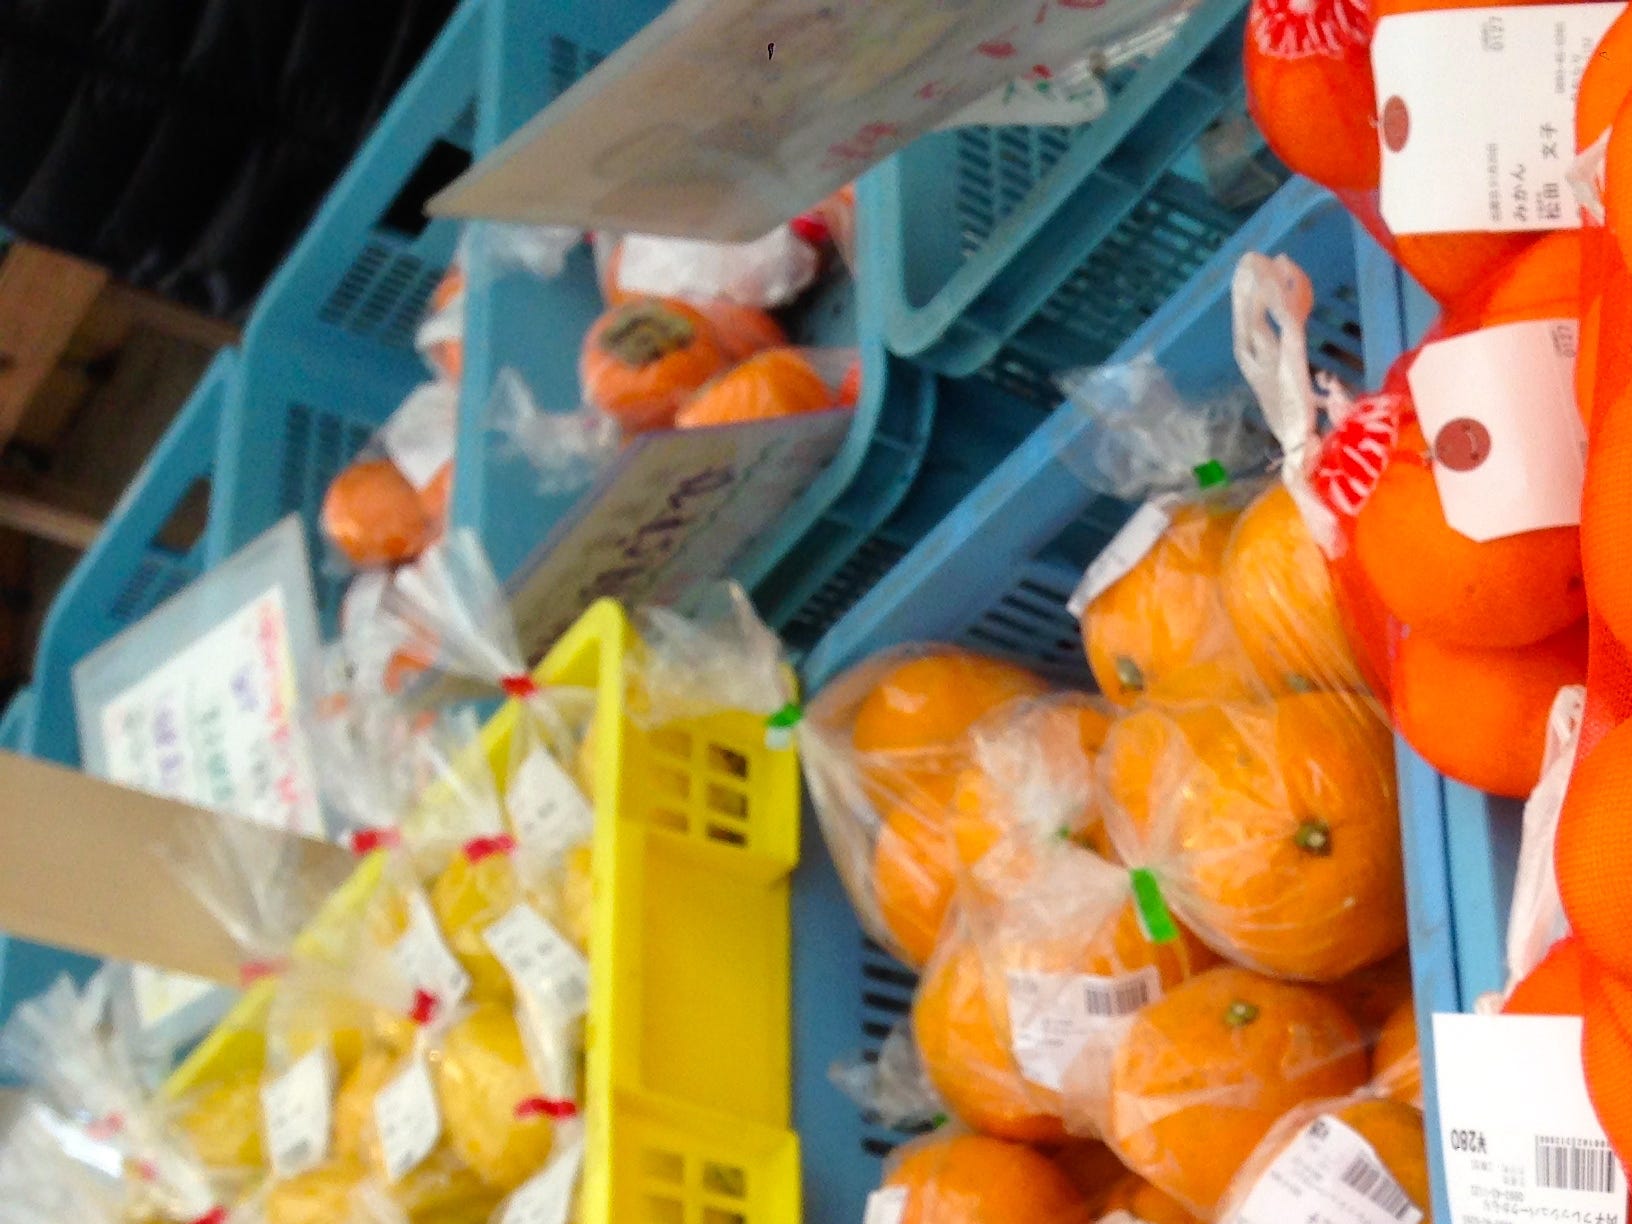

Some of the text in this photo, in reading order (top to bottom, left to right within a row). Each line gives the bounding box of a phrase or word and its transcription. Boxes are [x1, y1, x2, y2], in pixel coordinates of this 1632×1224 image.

[1509, 163, 1527, 222] みかん
[1449, 1128, 1487, 1154] ¥280
